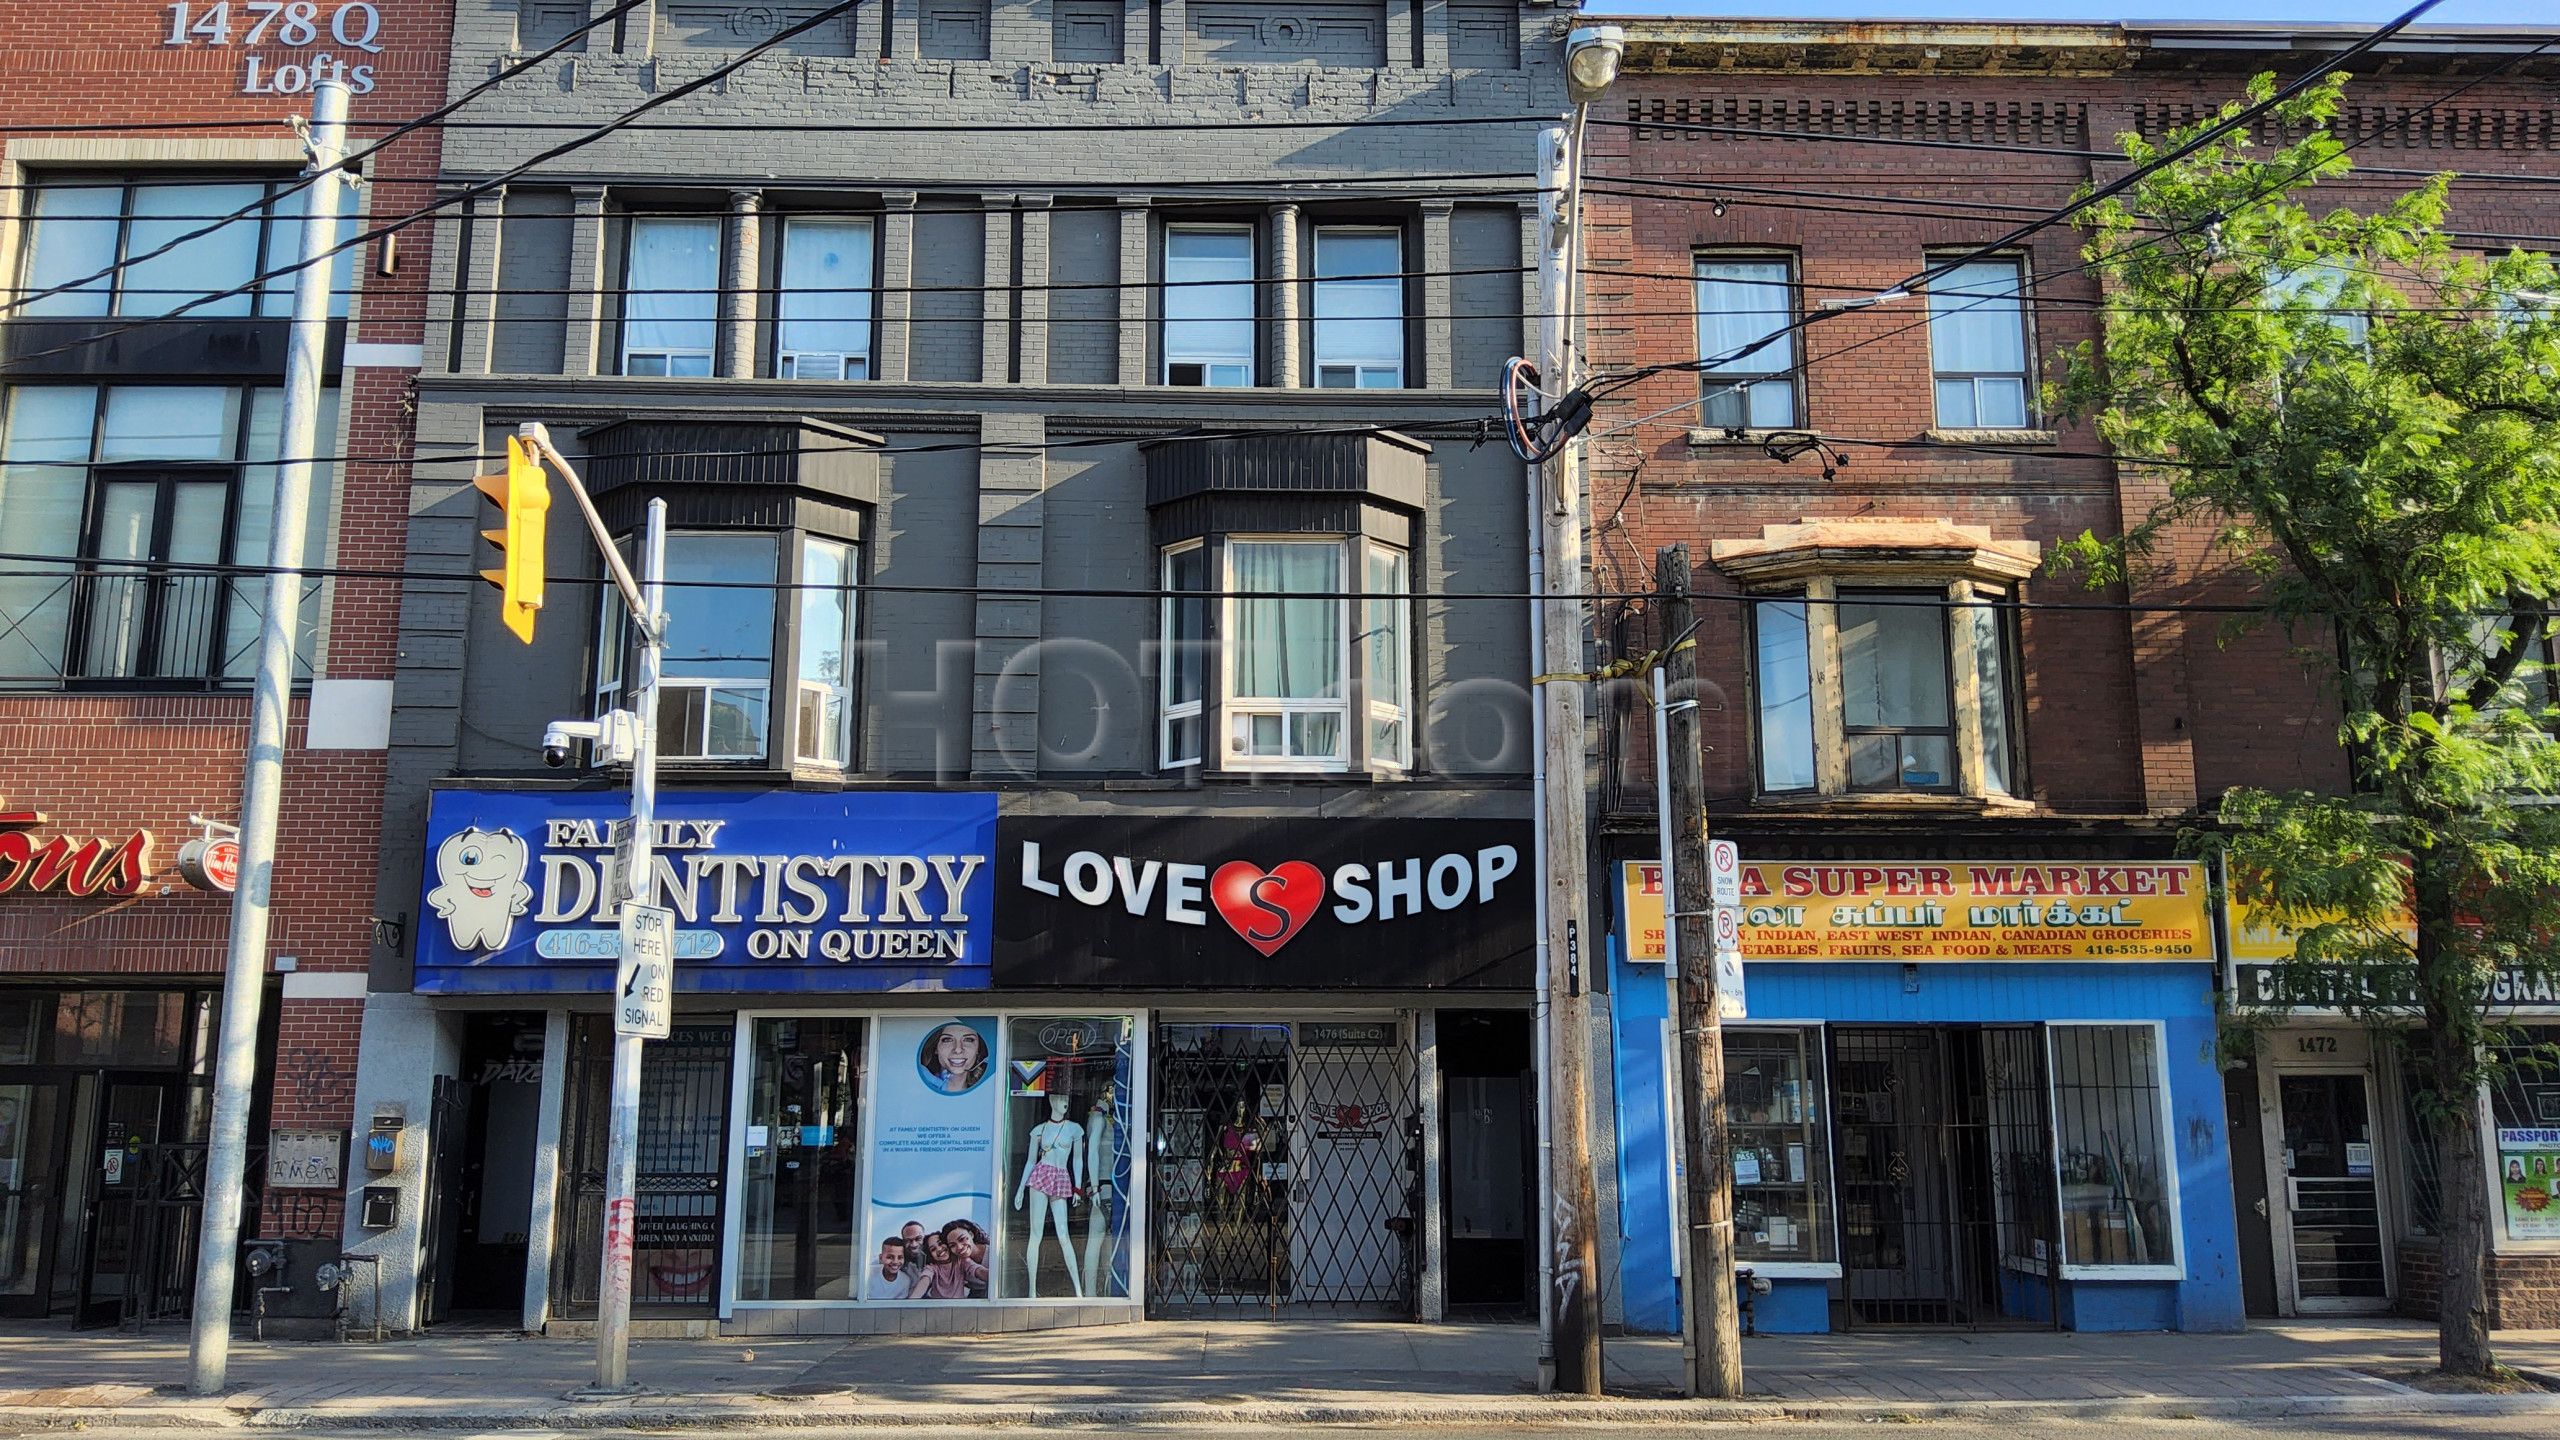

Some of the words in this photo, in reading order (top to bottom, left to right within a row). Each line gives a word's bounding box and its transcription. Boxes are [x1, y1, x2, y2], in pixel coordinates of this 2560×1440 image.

[163, 1, 318, 46] 1478
[331, 1, 383, 54] Q
[241, 53, 375, 94] Lofts
[545, 819, 725, 848] FAILY
[1640, 866, 1771, 897] BA
[1782, 866, 1956, 897] SUPER
[1968, 866, 2191, 897] MARKET
[1717, 876, 1733, 886] SNOW
[1022, 841, 1206, 926] LOVE
[1247, 876, 1291, 941] S
[1332, 844, 1518, 924] SHOP
[1716, 887, 1735, 897] ROUTE
[635, 914, 662, 933] STOP
[1757, 930, 1821, 942] INDIAN,
[1827, 930, 1869, 941] EAST
[1876, 930, 1923, 941] WEST
[1931, 930, 1997, 942] INDIAN,
[2001, 929, 2087, 941] CANADIAN
[2091, 929, 2193, 941] GROCERIES
[633, 938, 661, 957] HERE
[746, 930, 813, 959] ON
[818, 929, 966, 963] QUEEN
[1828, 944, 1897, 956] FRUITS,
[1902, 944, 1934, 955] SEA
[1942, 944, 1993, 955] FOOD
[1995, 944, 2009, 955] &
[2014, 944, 2073, 955] MEATS
[2085, 943, 2193, 955] 416-535-9450
[651, 964, 665, 980] ON
[643, 986, 664, 1003] RED
[625, 1008, 663, 1028] SIGNAL
[1042, 1028, 1092, 1046] OPEN
[1314, 1029, 1336, 1040] 1476
[1339, 1028, 1366, 1041] (Suite
[1367, 1028, 1383, 1041] C2)
[2298, 1036, 2337, 1053] 1472
[1310, 1102, 1336, 1119] LOVE
[1360, 1102, 1390, 1119] SHOP
[1736, 1152, 1755, 1161] PASS
